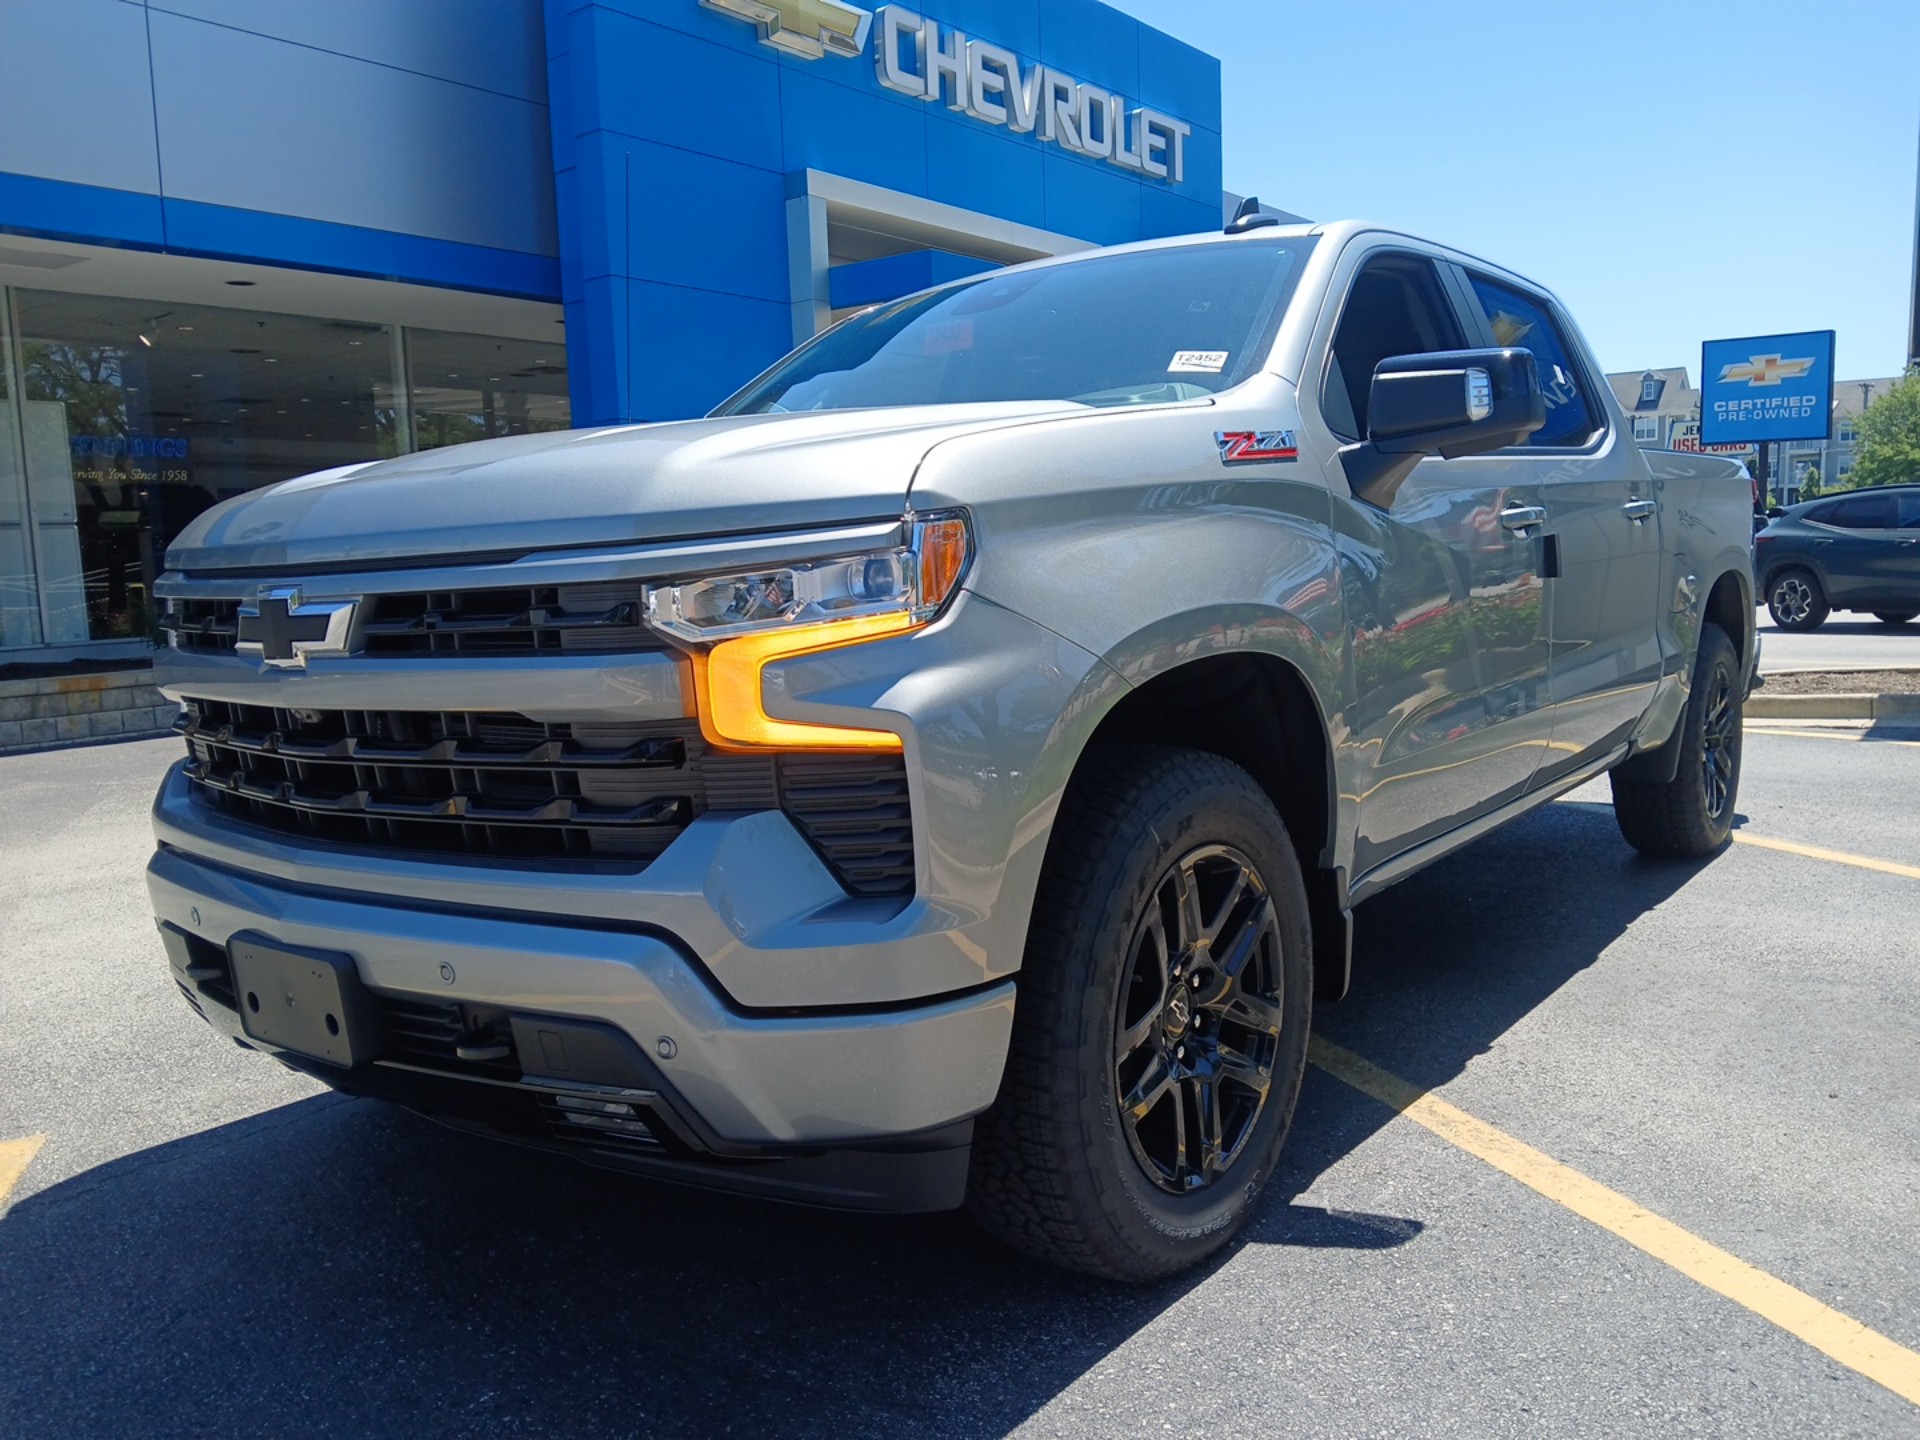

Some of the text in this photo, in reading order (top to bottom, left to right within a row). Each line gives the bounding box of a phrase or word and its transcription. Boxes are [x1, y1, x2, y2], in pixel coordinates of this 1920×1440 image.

[875, 4, 1191, 183] CHEVROLET
[1177, 353, 1223, 363] T2452
[1714, 395, 1816, 412] CERTIFIED
[1718, 407, 1811, 422] PRE-OWNED
[1214, 430, 1299, 467] Z71
[108, 468, 126, 479] You
[130, 468, 158, 480] Since
[161, 470, 188, 481] 1958
